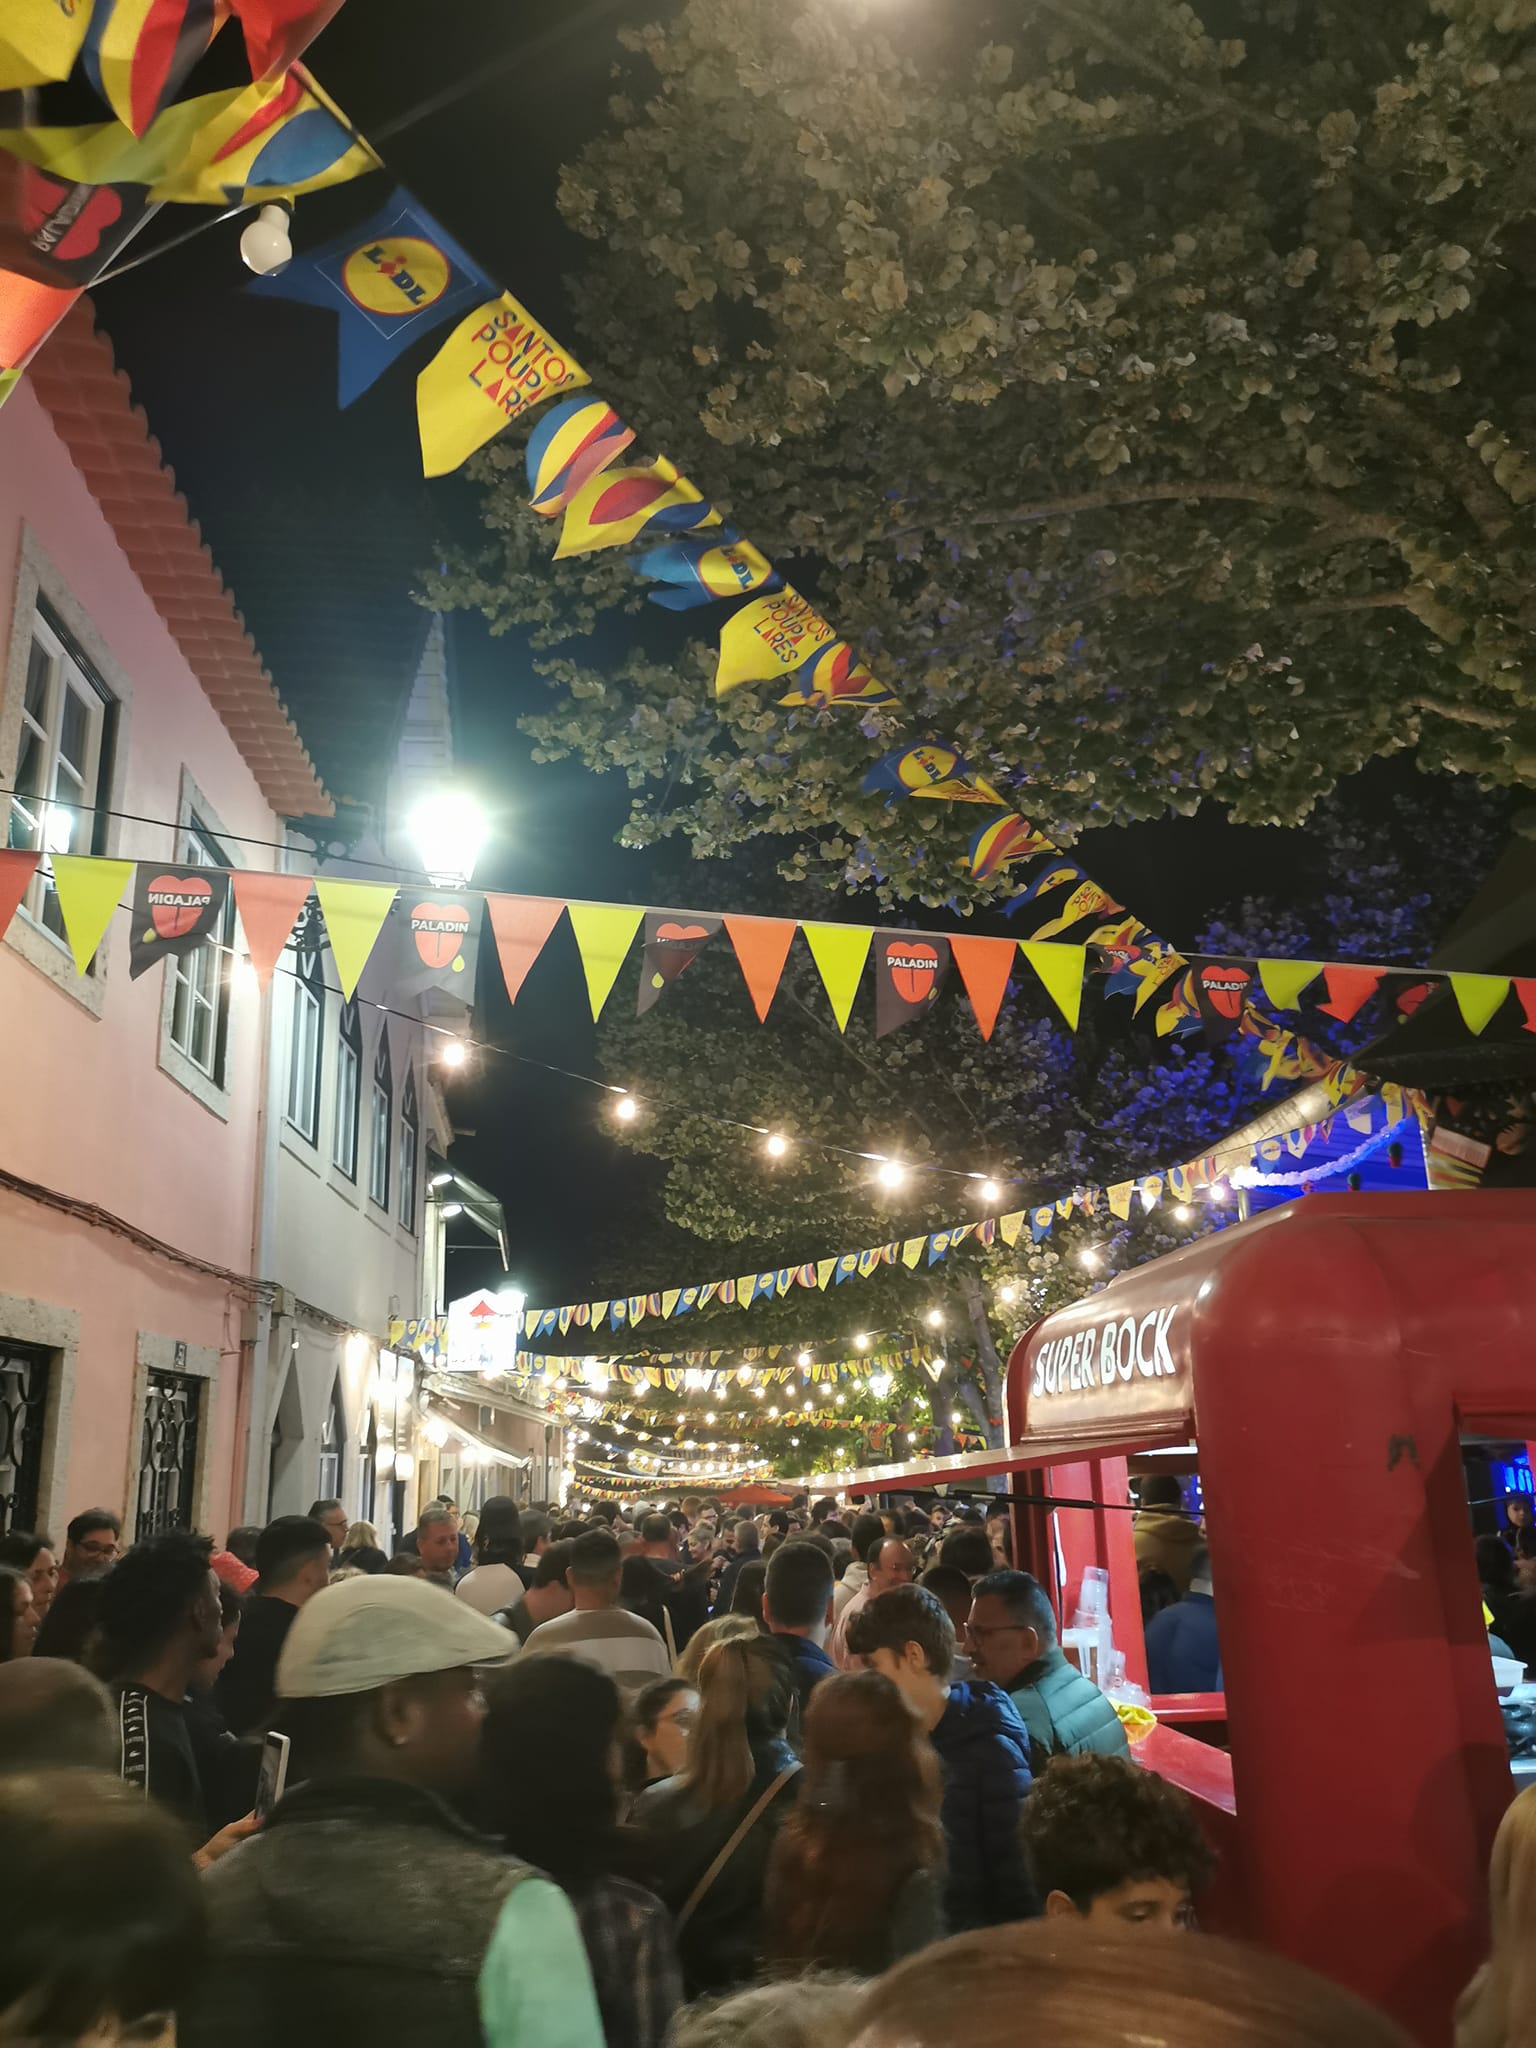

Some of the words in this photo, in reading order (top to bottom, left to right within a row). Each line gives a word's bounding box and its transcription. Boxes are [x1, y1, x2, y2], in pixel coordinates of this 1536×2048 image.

[363, 246, 426, 305] LIDL
[472, 323, 548, 402] POUPA
[494, 310, 574, 387] SANTOS
[753, 617, 798, 663] LARES
[762, 601, 805, 645] POUPA
[411, 919, 469, 932] PALADIN
[887, 956, 938, 969] PALADIN
[1032, 1327, 1097, 1397] SUPER
[1100, 1304, 1178, 1385] BOCK
